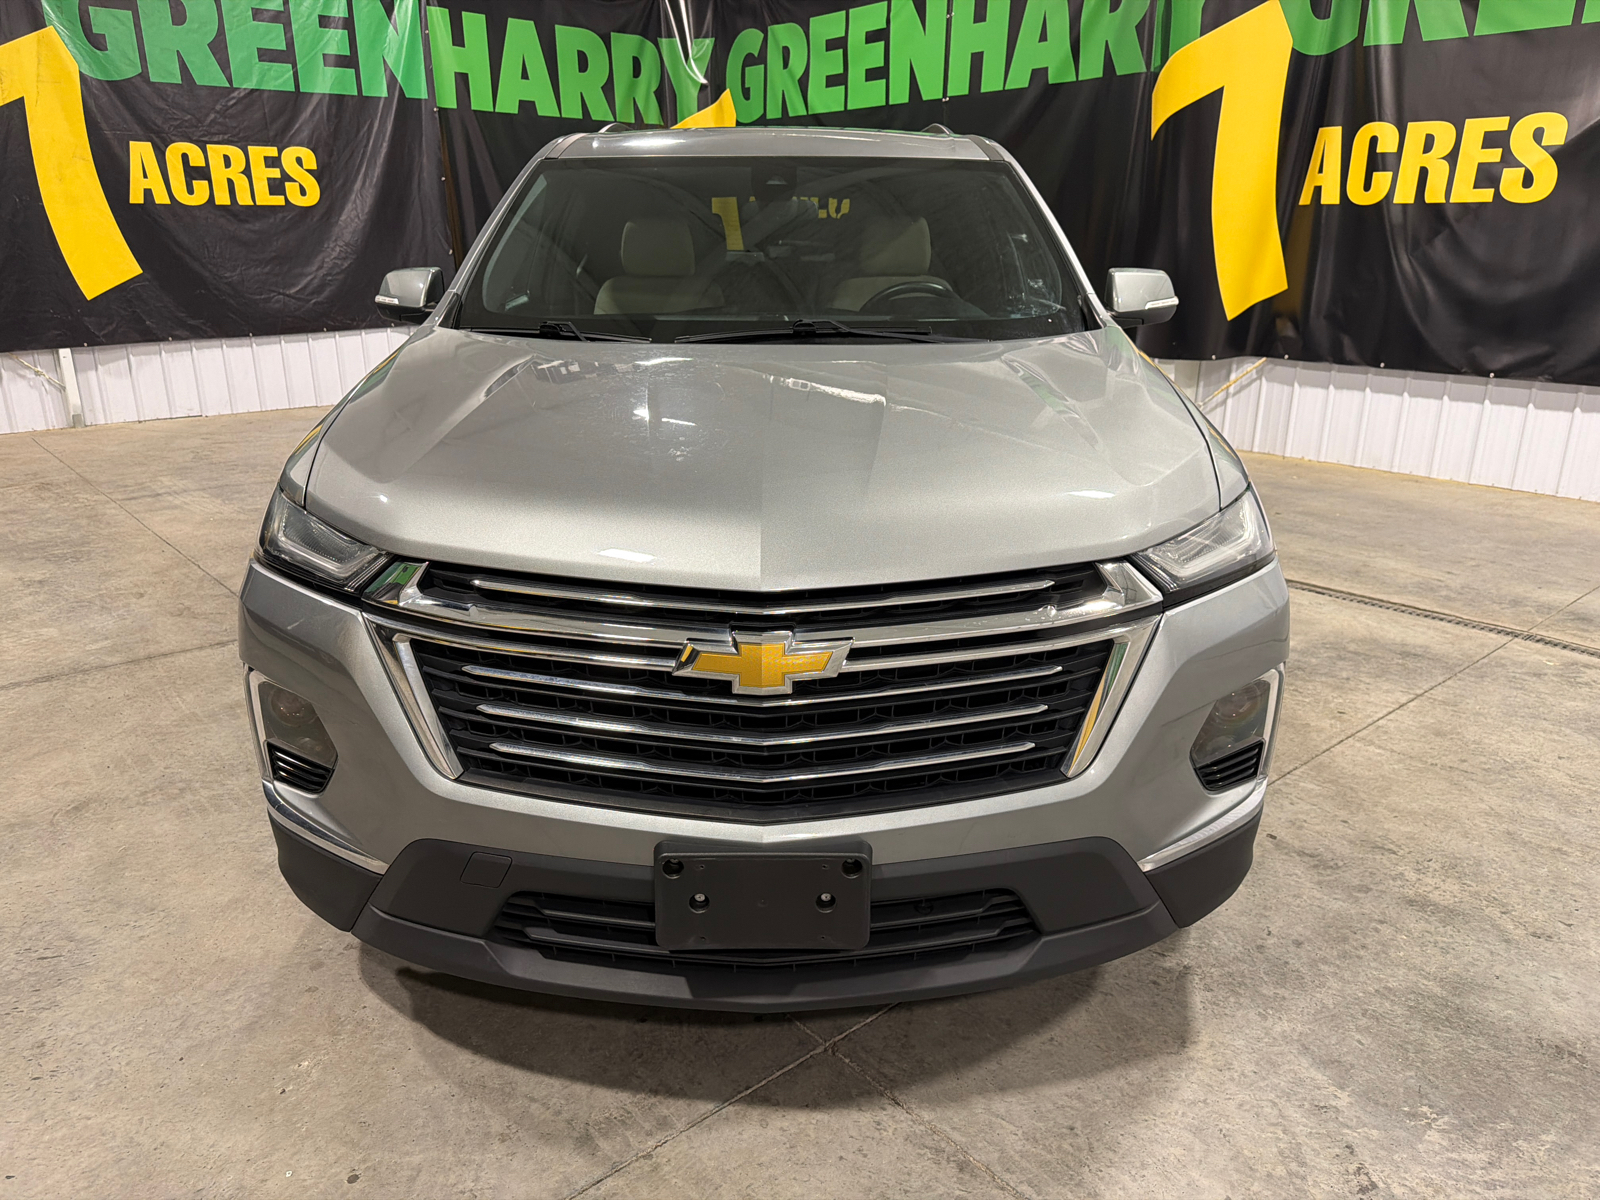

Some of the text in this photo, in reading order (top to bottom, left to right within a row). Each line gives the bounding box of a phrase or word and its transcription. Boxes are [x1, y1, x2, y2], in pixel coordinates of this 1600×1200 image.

[45, 0, 428, 99] GREEN
[427, 0, 949, 126] HARRY GREEN
[128, 140, 321, 207] ACRES
[1299, 111, 1569, 206] ACRES
